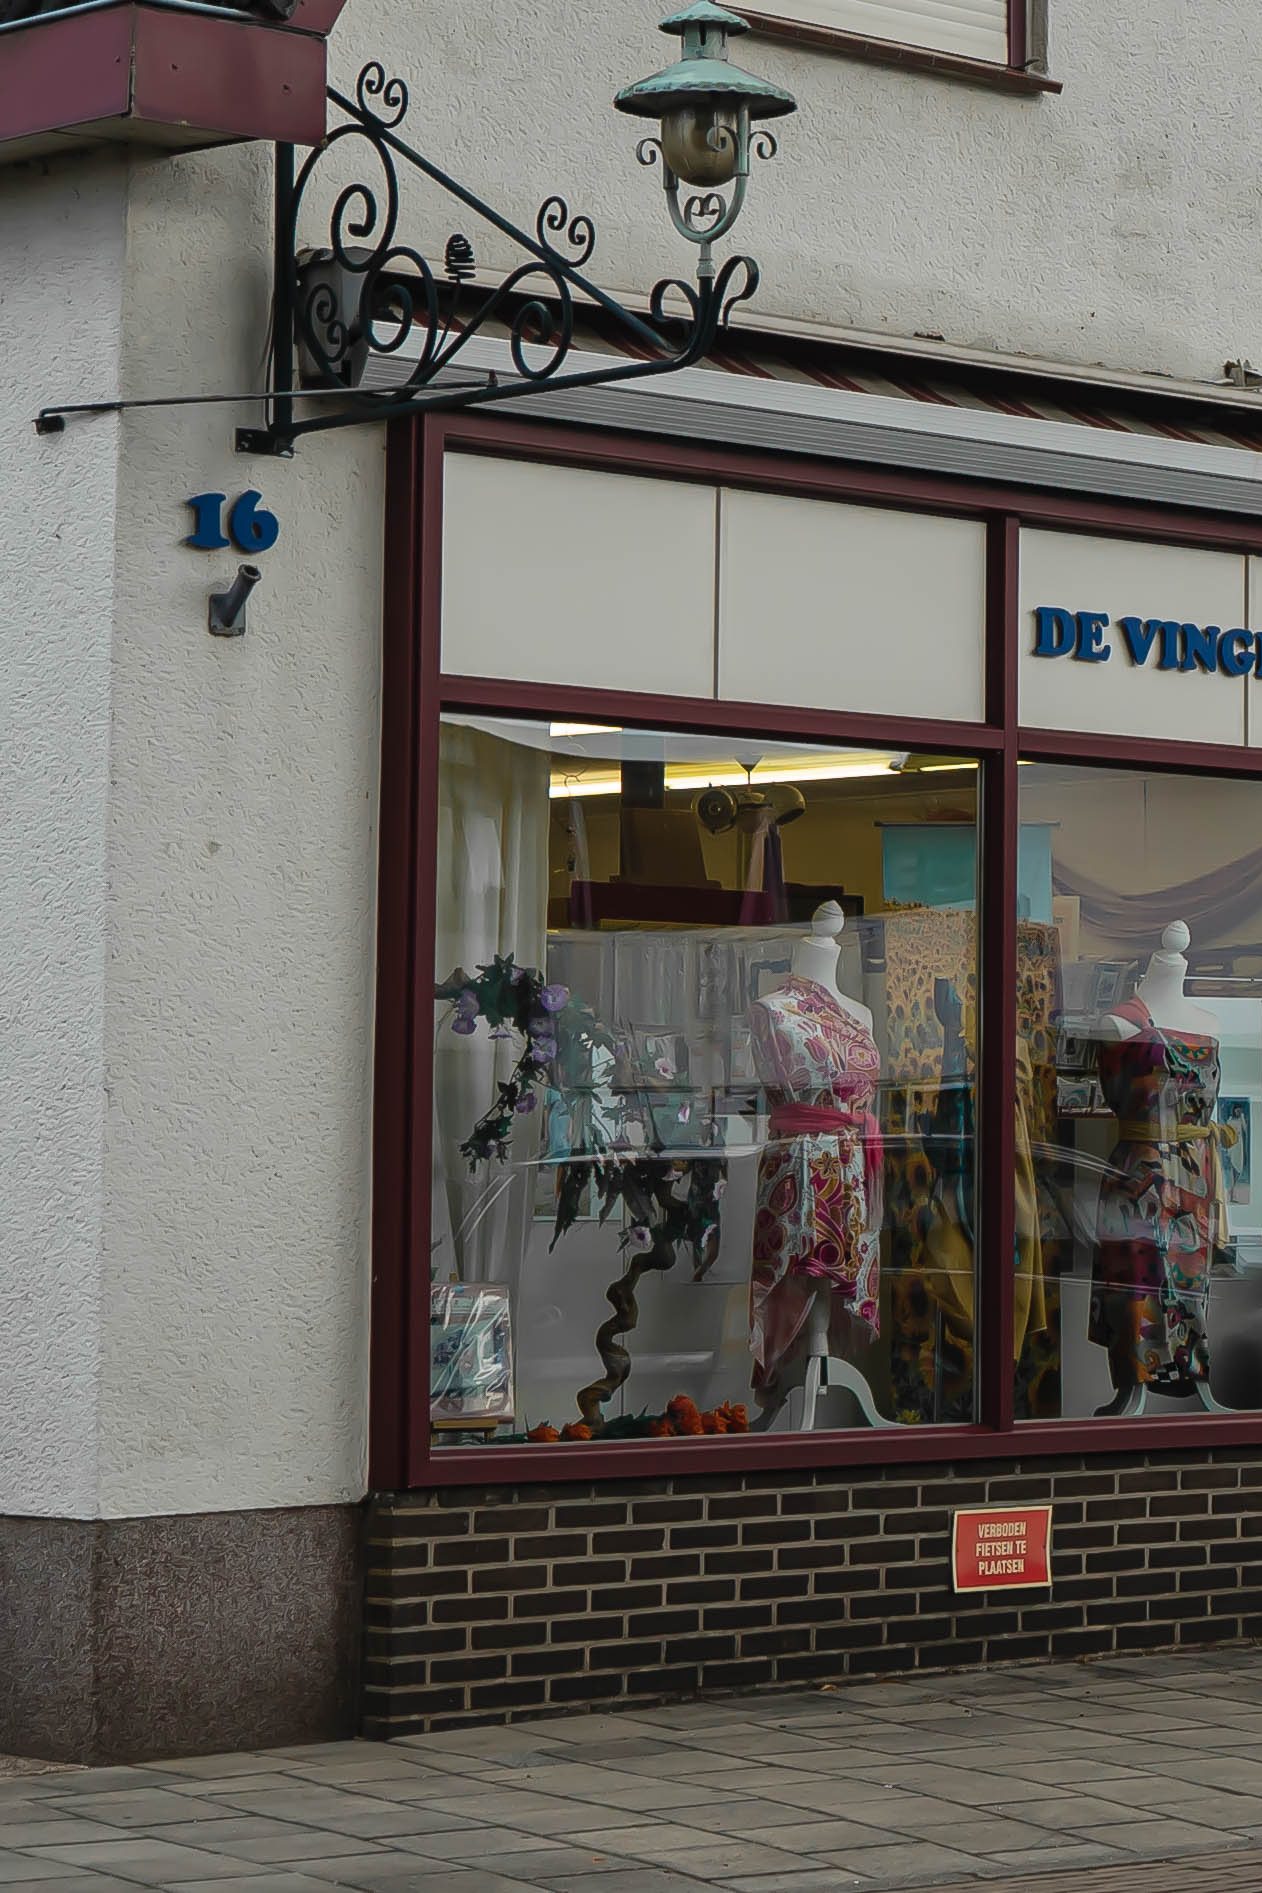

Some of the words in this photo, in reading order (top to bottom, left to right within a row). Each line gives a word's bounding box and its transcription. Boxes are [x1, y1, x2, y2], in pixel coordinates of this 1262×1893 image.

[185, 489, 280, 552] 16
[1035, 606, 1112, 662] DE
[978, 1521, 1027, 1538] VERBODEN
[975, 1541, 1013, 1557] FIETSEN
[1016, 1540, 1027, 1554] TE
[979, 1559, 1025, 1575] PLAATSEN
